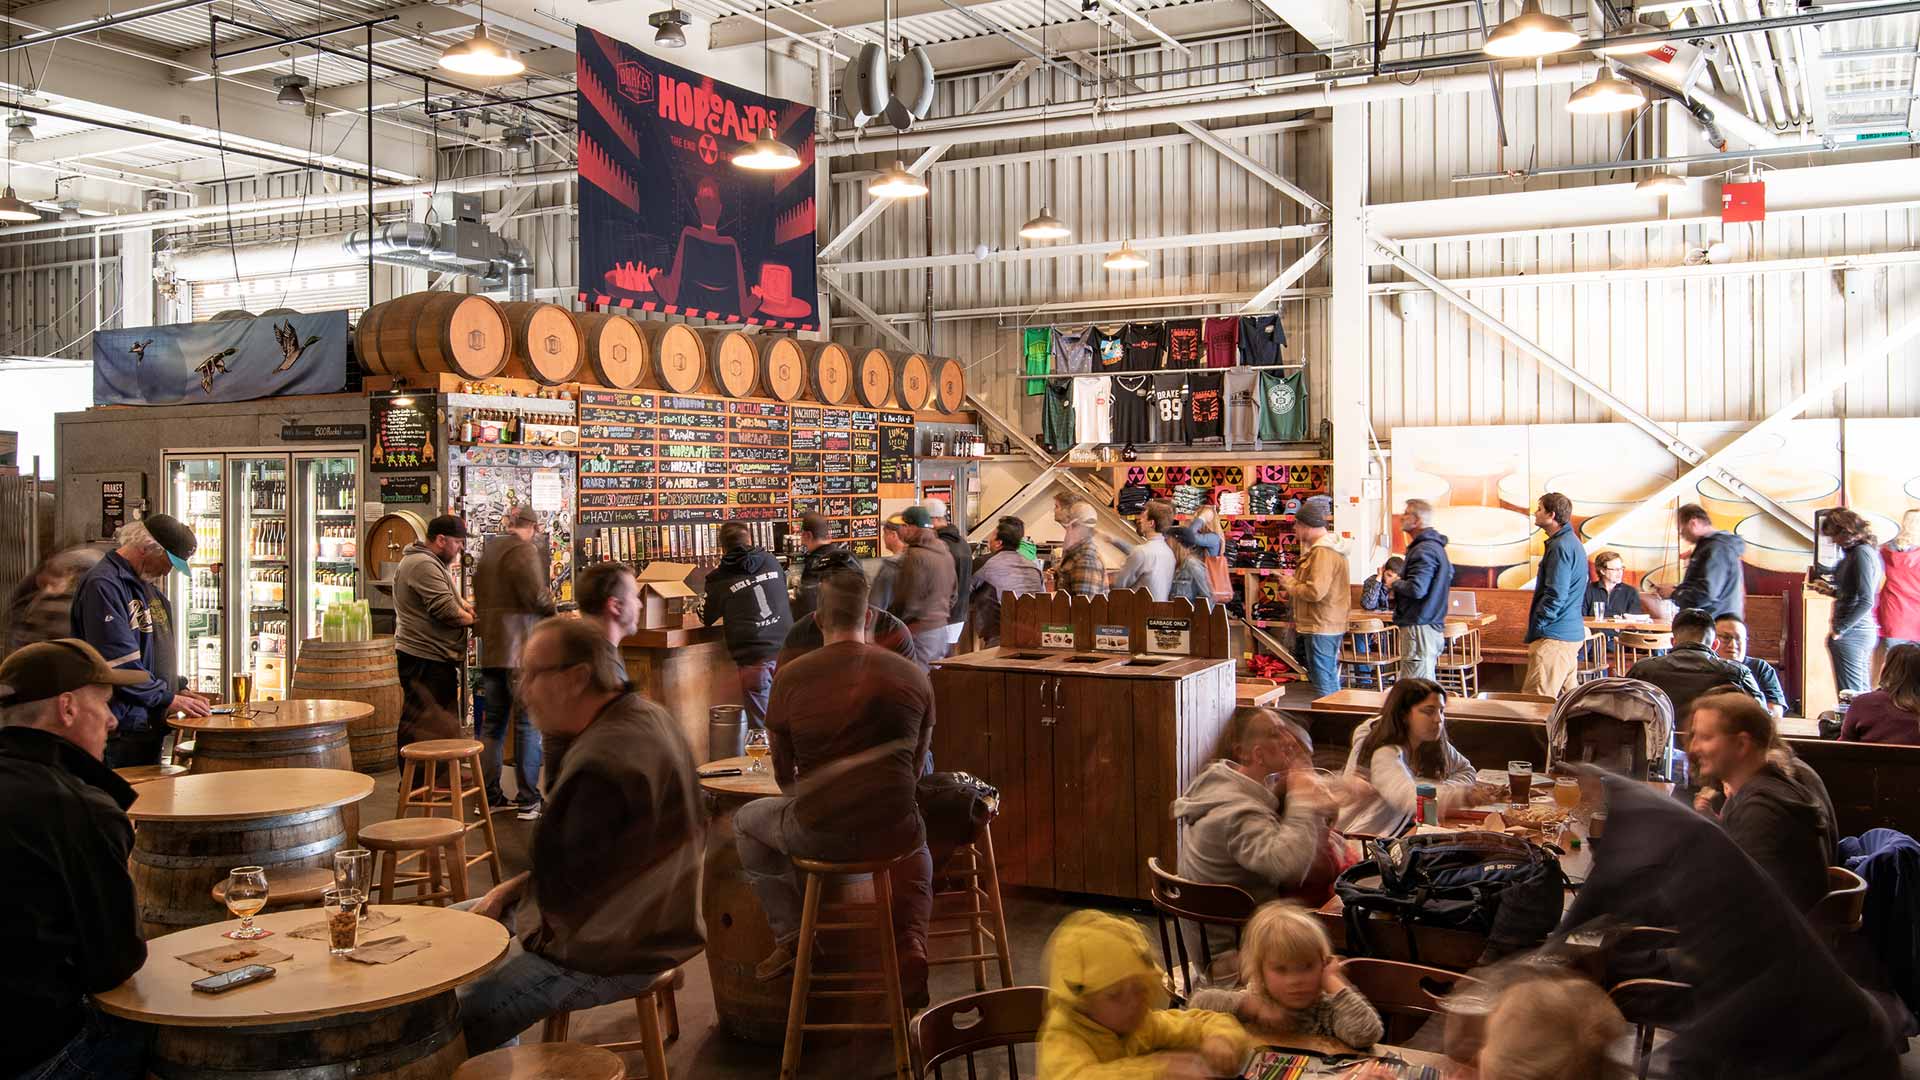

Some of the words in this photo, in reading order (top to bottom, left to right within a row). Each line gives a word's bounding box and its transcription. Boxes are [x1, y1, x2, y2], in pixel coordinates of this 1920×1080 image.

[1157, 390, 1179, 401] DRAKE
[1159, 399, 1183, 422] 89
[889, 428, 908, 440] LUNCH
[674, 478, 698, 489] AMBER
[591, 511, 614, 523] HAZY
